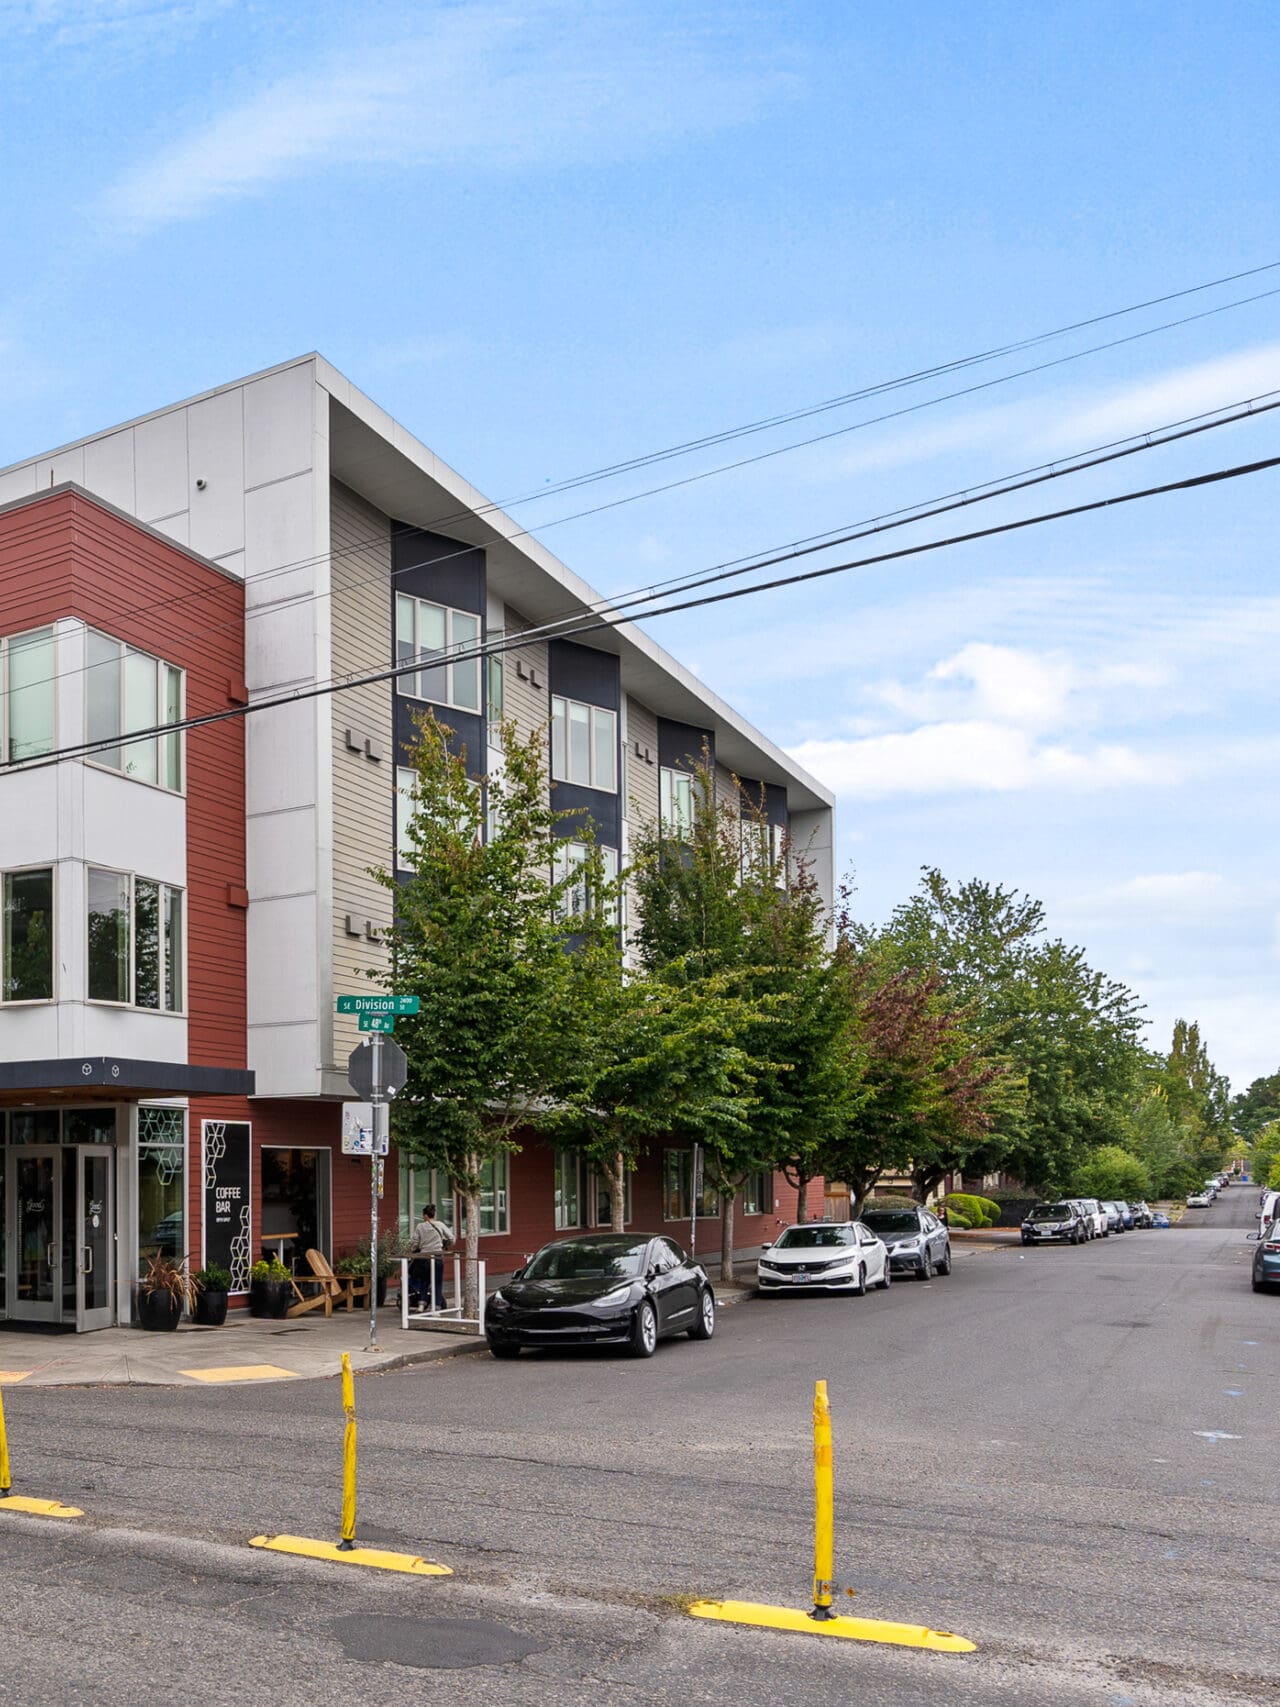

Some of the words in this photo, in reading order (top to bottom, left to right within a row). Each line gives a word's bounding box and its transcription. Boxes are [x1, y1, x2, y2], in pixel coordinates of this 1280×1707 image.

[356, 998, 394, 1010] Division
[215, 1186, 241, 1199] COFFEE
[215, 1200, 231, 1214] BAR
